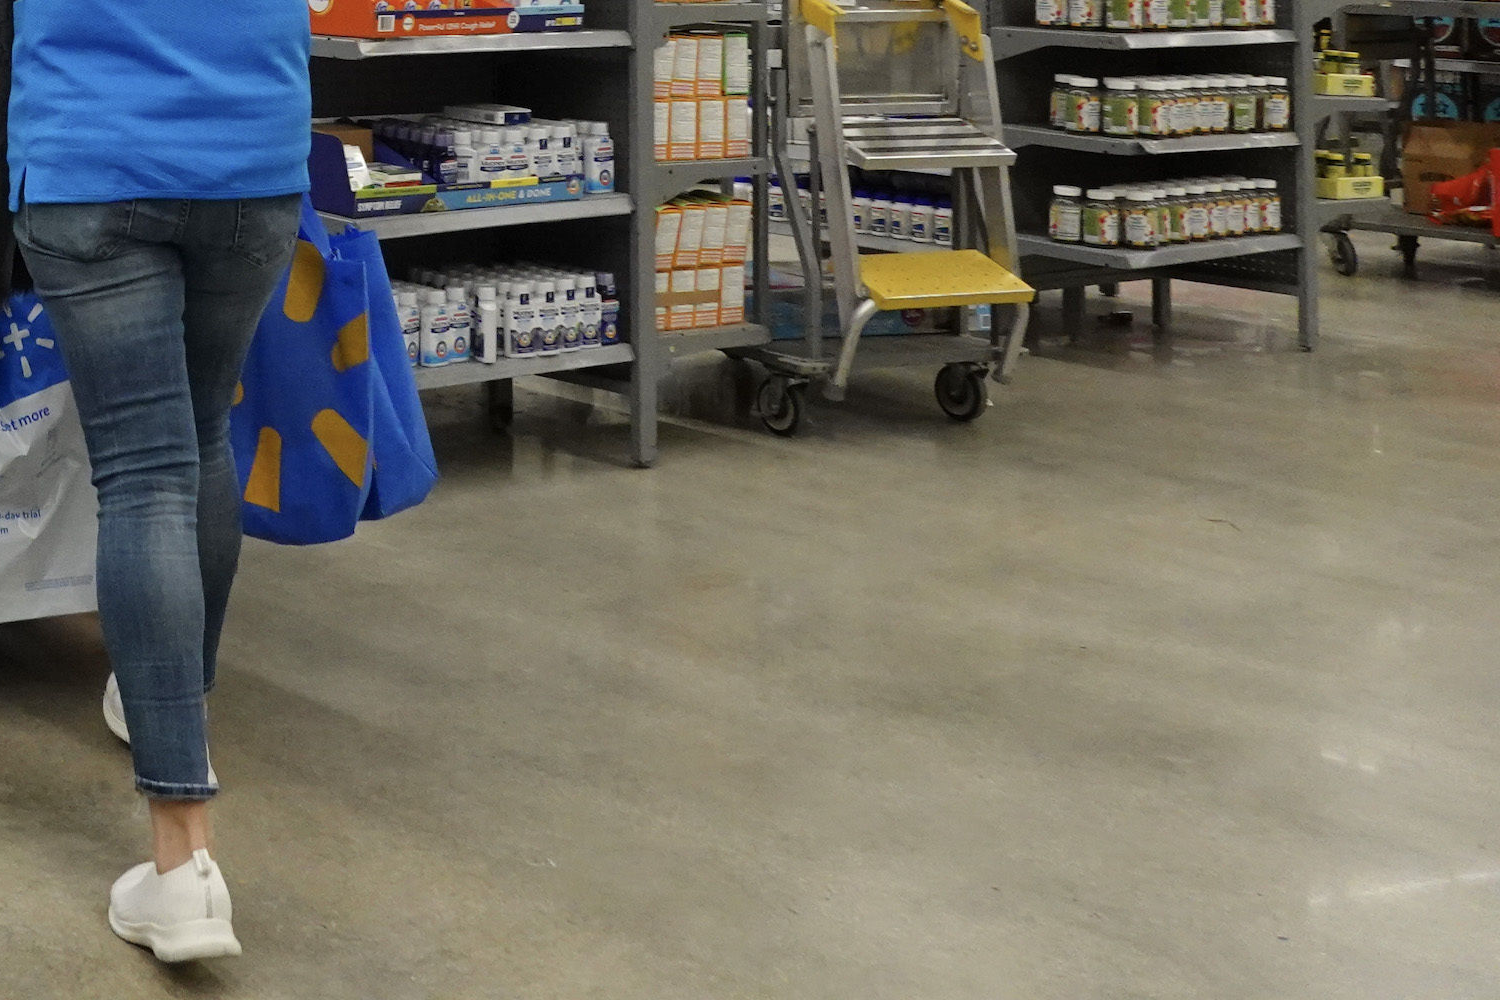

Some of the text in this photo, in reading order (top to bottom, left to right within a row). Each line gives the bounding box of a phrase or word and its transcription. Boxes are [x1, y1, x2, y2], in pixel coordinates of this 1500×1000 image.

[526, 187, 551, 198] DONE
[19, 407, 50, 427] more
[23, 510, 41, 519] trial
